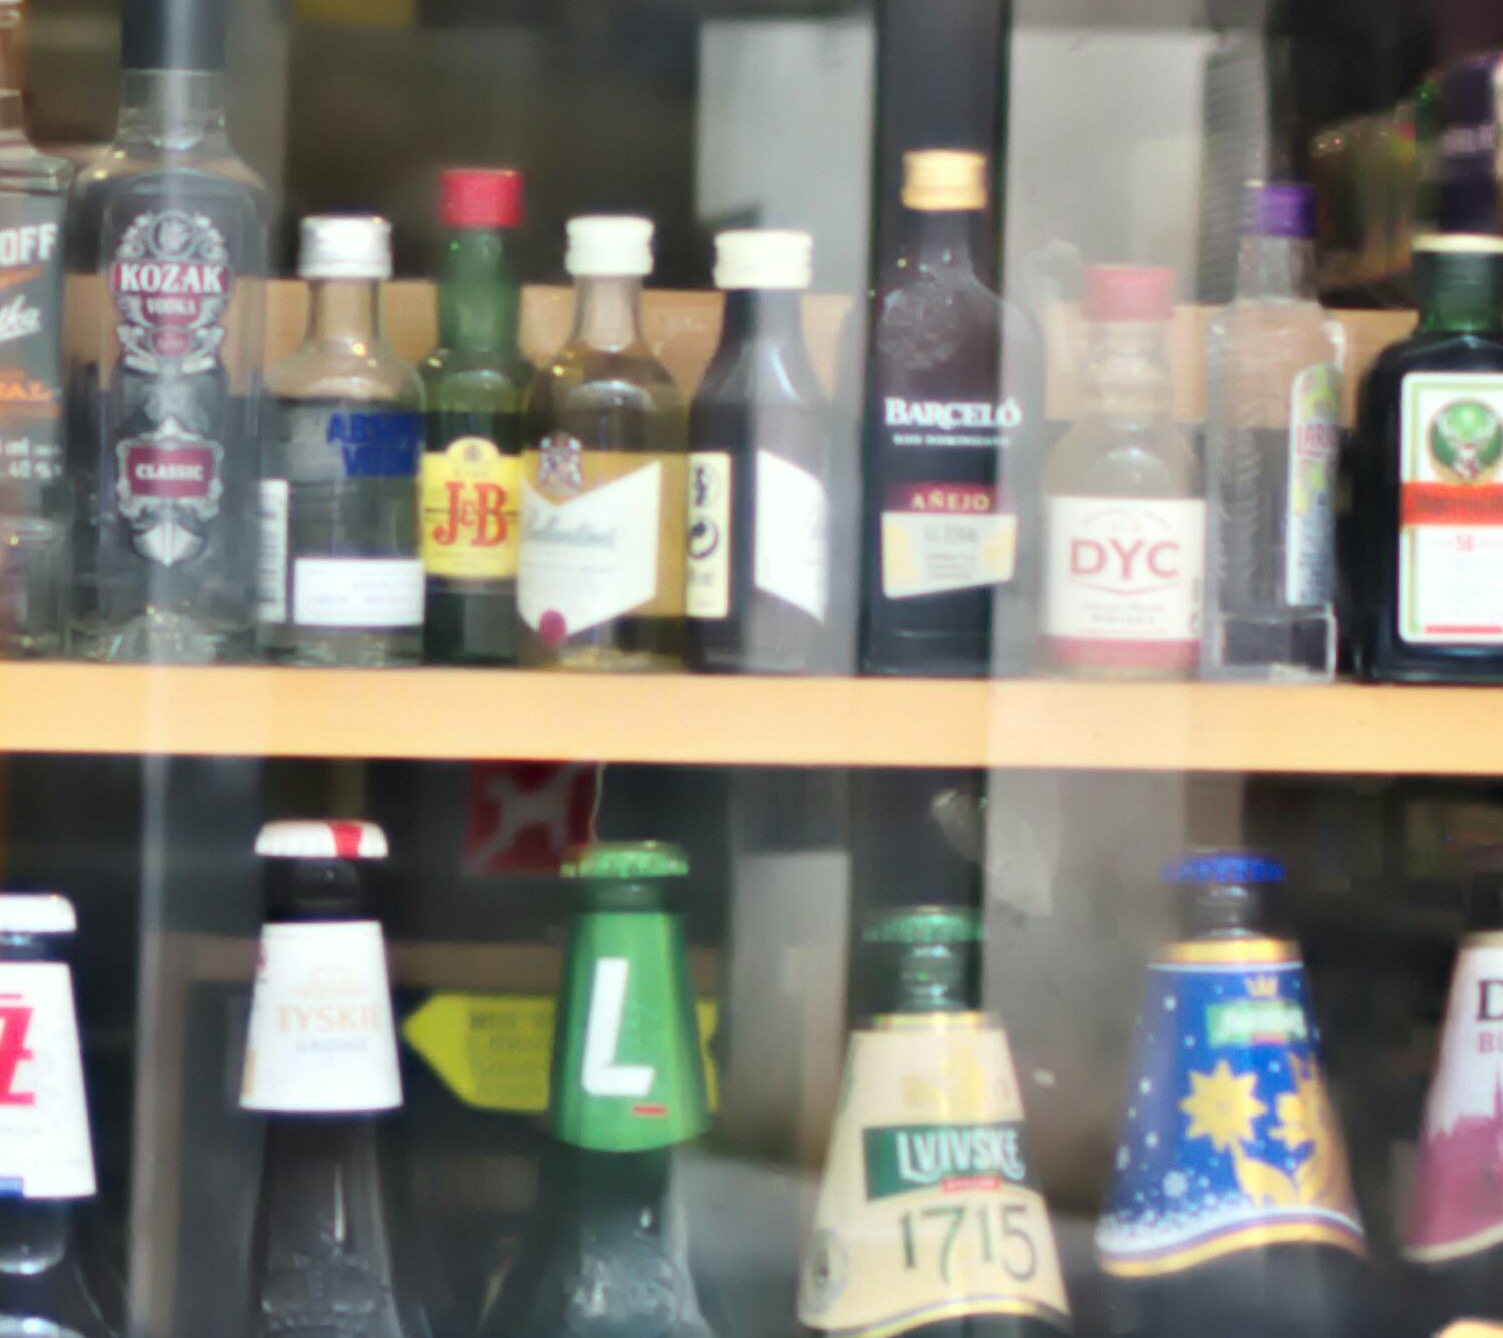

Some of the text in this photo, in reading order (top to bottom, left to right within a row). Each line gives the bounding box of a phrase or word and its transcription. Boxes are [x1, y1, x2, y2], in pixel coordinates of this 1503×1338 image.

[120, 263, 224, 294] KOZAK
[884, 396, 1023, 430] BARCELÓ
[135, 464, 204, 482] CLASSIC
[432, 480, 509, 548] J&B
[911, 491, 991, 512] AÑEJO
[1069, 538, 1181, 582] DYC
[276, 1004, 384, 1033] TYSKIE
[581, 957, 655, 1098] L
[895, 1128, 1027, 1184] LVIVSKE
[896, 1202, 1040, 1286] 1715
